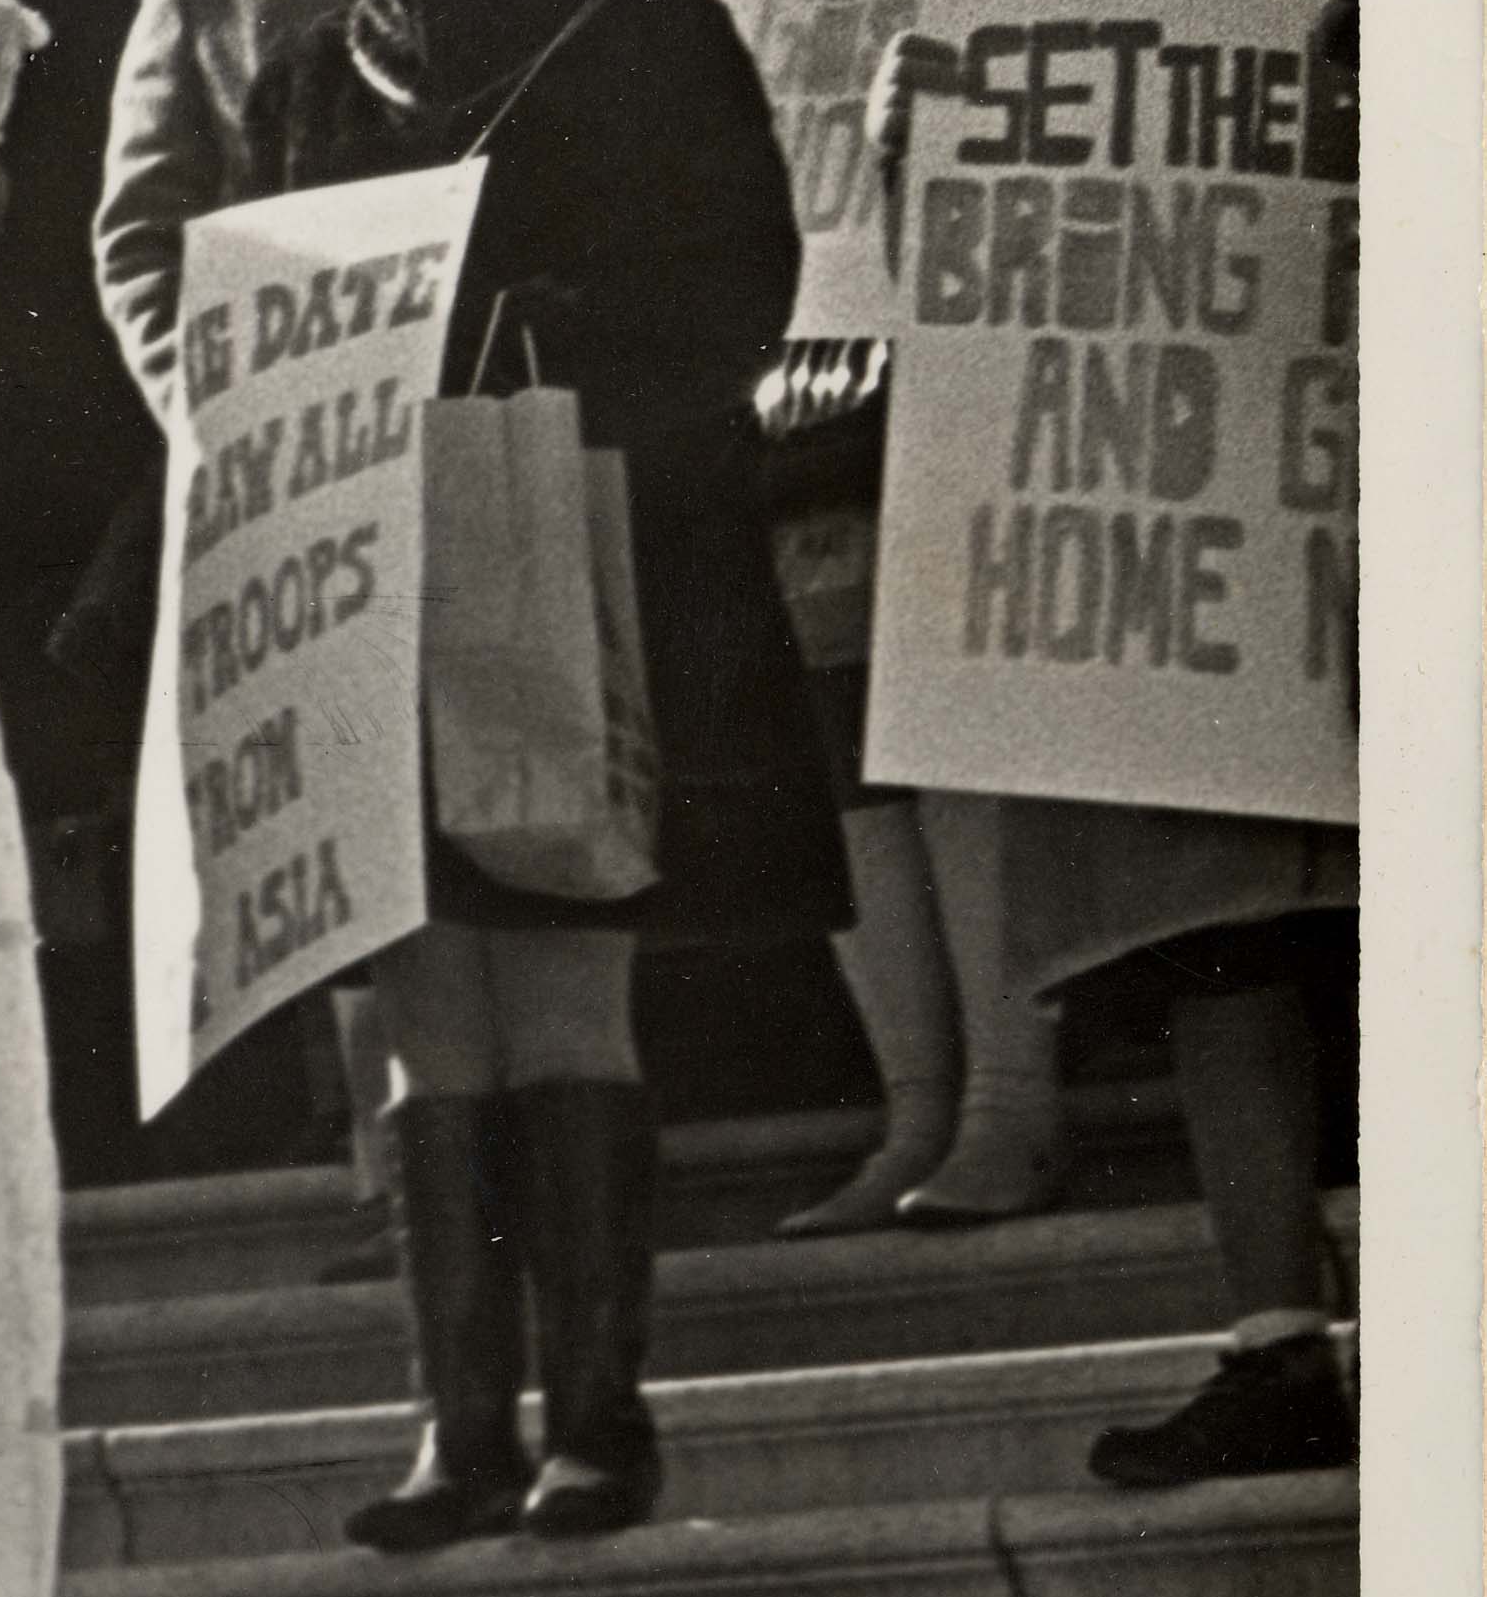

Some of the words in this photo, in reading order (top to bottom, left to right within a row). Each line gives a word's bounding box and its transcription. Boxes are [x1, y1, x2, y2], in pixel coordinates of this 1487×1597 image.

[957, 19, 1162, 170] SET
[1160, 44, 1302, 176] THE
[250, 241, 451, 376] DATE
[288, 374, 416, 500] ALL
[1011, 337, 1219, 502] AND
[964, 502, 1245, 675] HOME
[236, 837, 353, 992] ASIA
